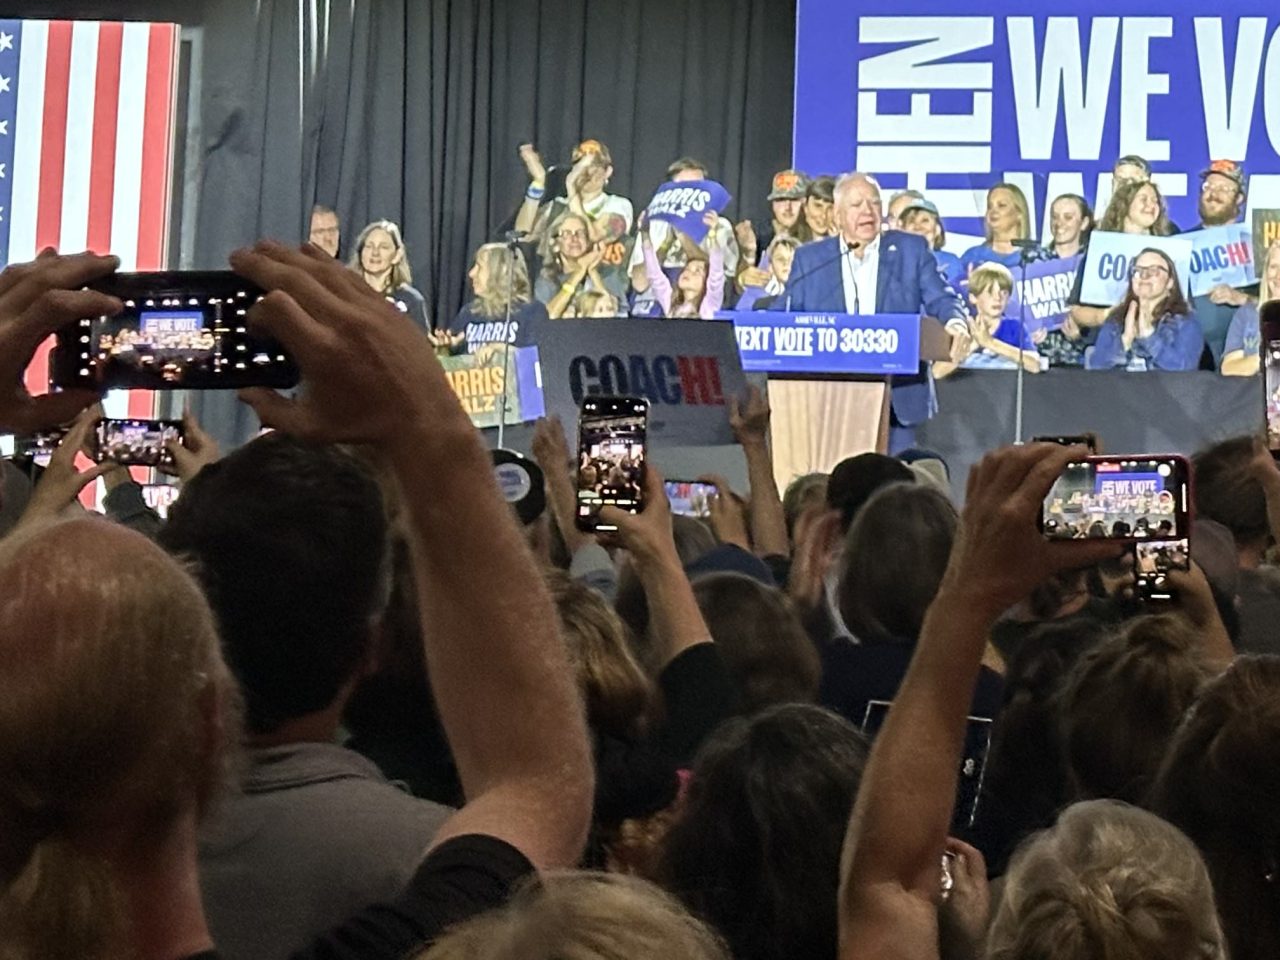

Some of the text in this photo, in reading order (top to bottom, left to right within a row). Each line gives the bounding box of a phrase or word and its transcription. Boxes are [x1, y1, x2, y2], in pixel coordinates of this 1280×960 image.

[1005, 15, 1173, 161] WE
[855, 15, 994, 258] HEN
[1190, 241, 1250, 274] OACH!
[1016, 270, 1078, 306] HARRI
[1030, 299, 1071, 319] WAL
[465, 321, 519, 343] HARRIS
[735, 325, 899, 354] TEXT VOTE TO 30330
